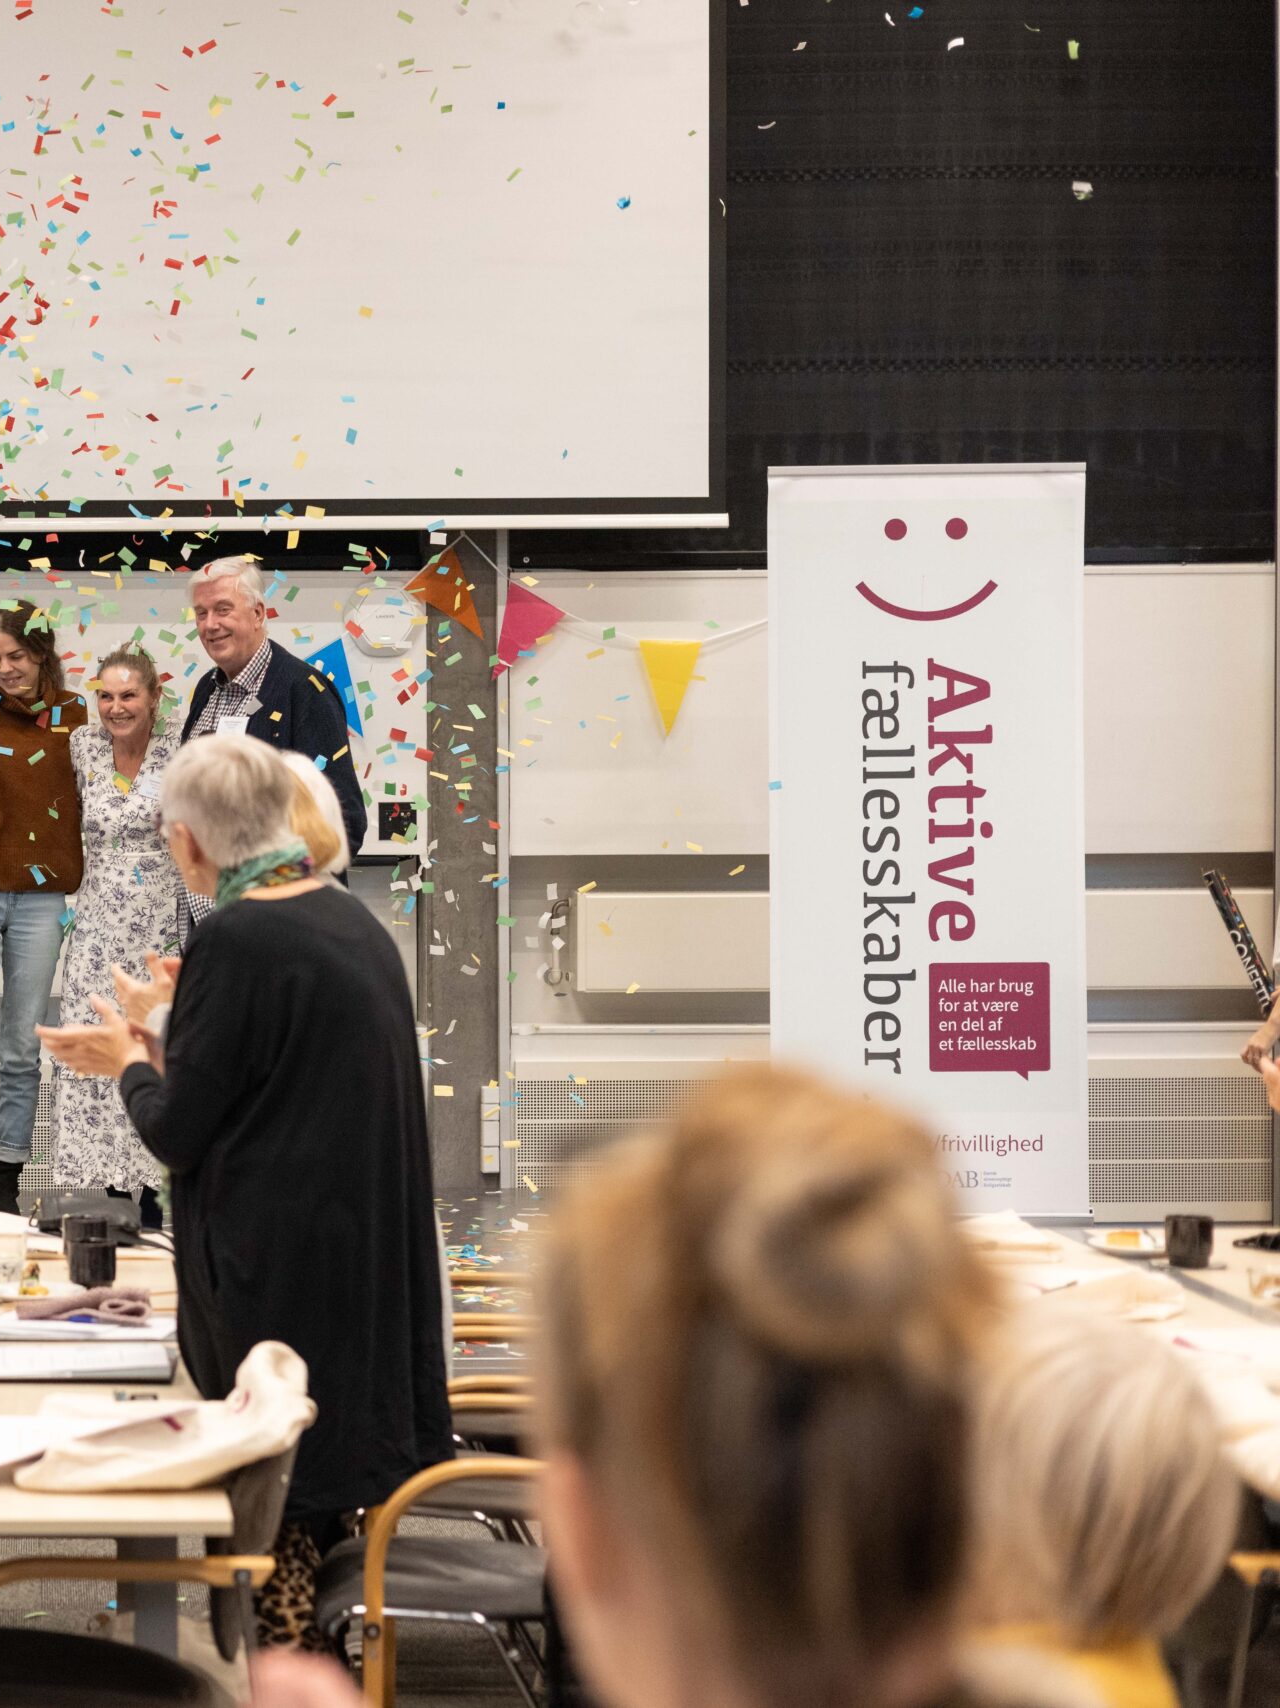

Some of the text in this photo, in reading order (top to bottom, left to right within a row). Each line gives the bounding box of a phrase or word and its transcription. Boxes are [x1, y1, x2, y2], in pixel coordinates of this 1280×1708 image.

[927, 657, 994, 942] Aktive
[862, 660, 917, 1075] fællesskaber
[938, 978, 1034, 997] Alle har brug
[938, 998, 1019, 1012] for at være
[939, 1017, 1004, 1031] en del af
[939, 1036, 1037, 1051] et fællesskab
[933, 1134, 1044, 1157] /frivillighed
